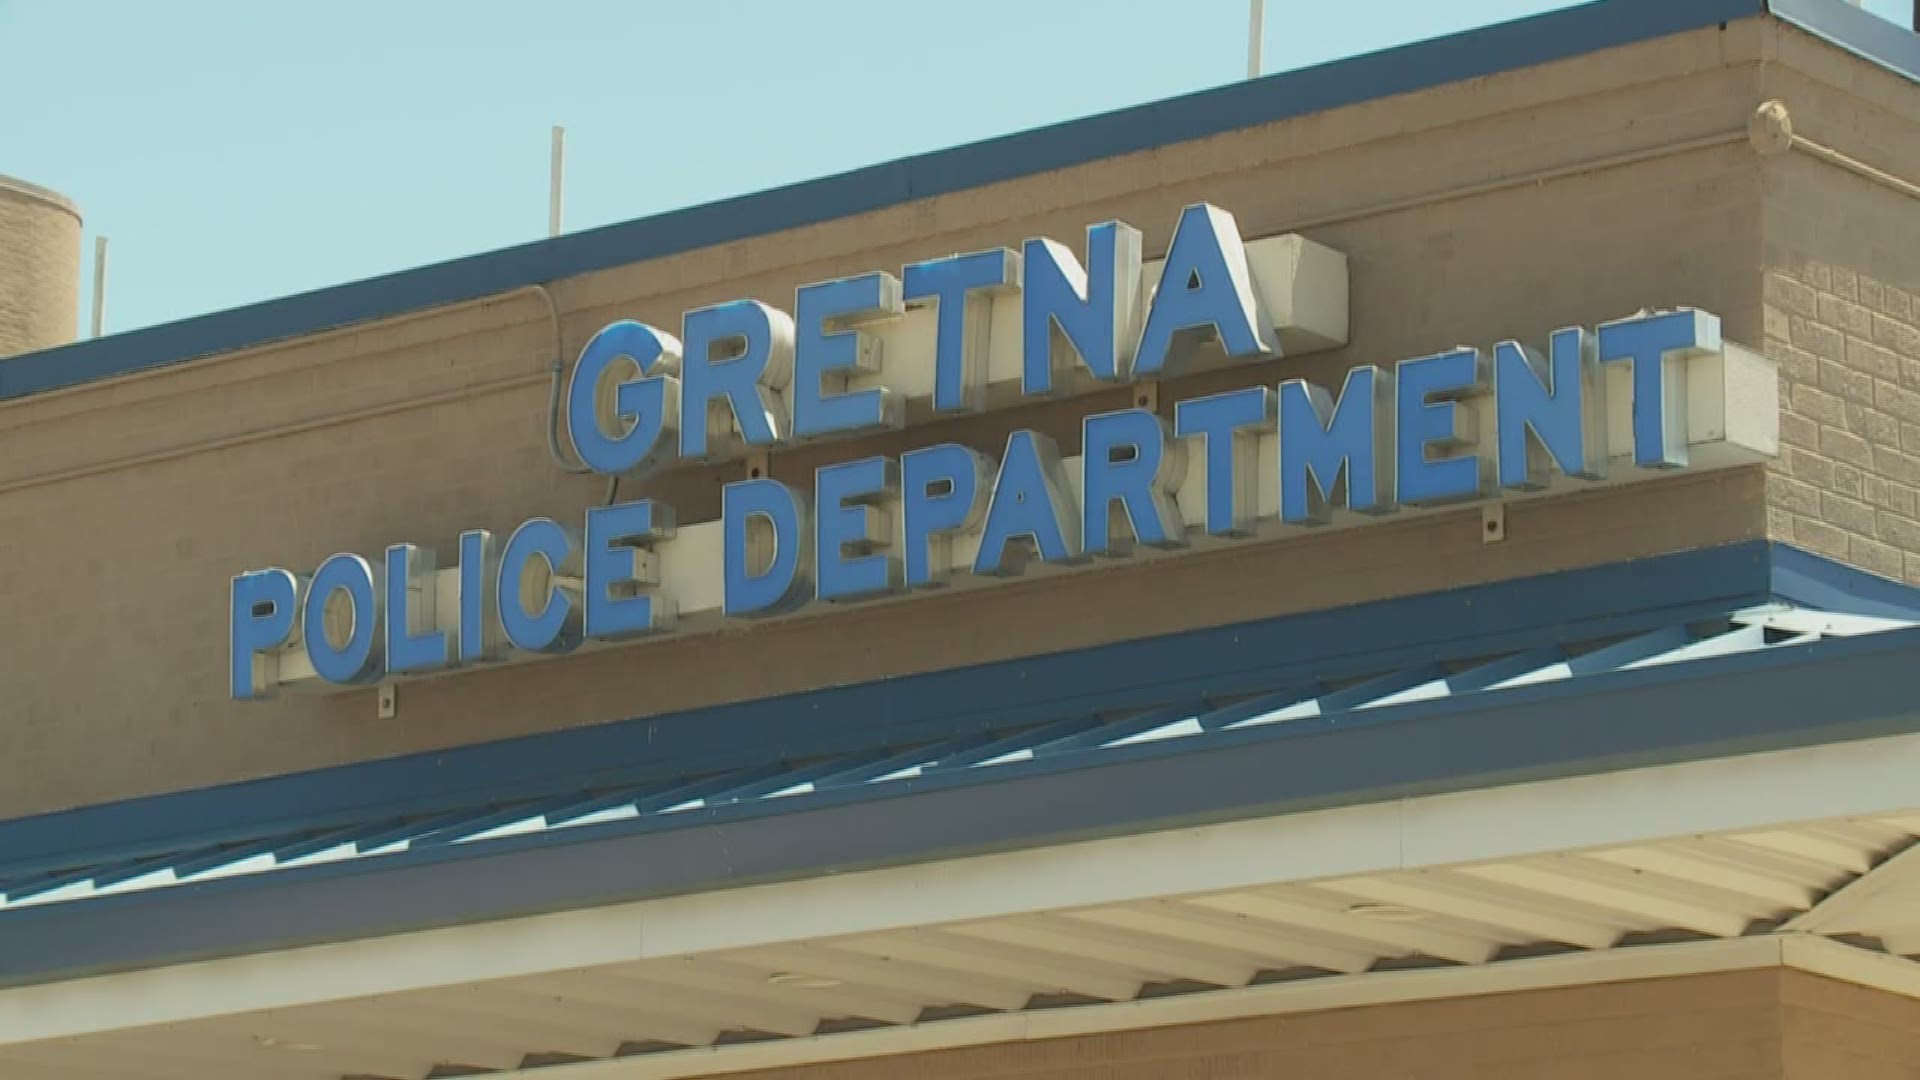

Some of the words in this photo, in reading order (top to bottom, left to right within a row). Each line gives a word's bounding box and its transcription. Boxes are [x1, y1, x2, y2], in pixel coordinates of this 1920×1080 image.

[230, 500, 662, 699] POLICE
[721, 309, 1712, 617] DEPARTMENT
[568, 203, 1272, 476] GRETNA
